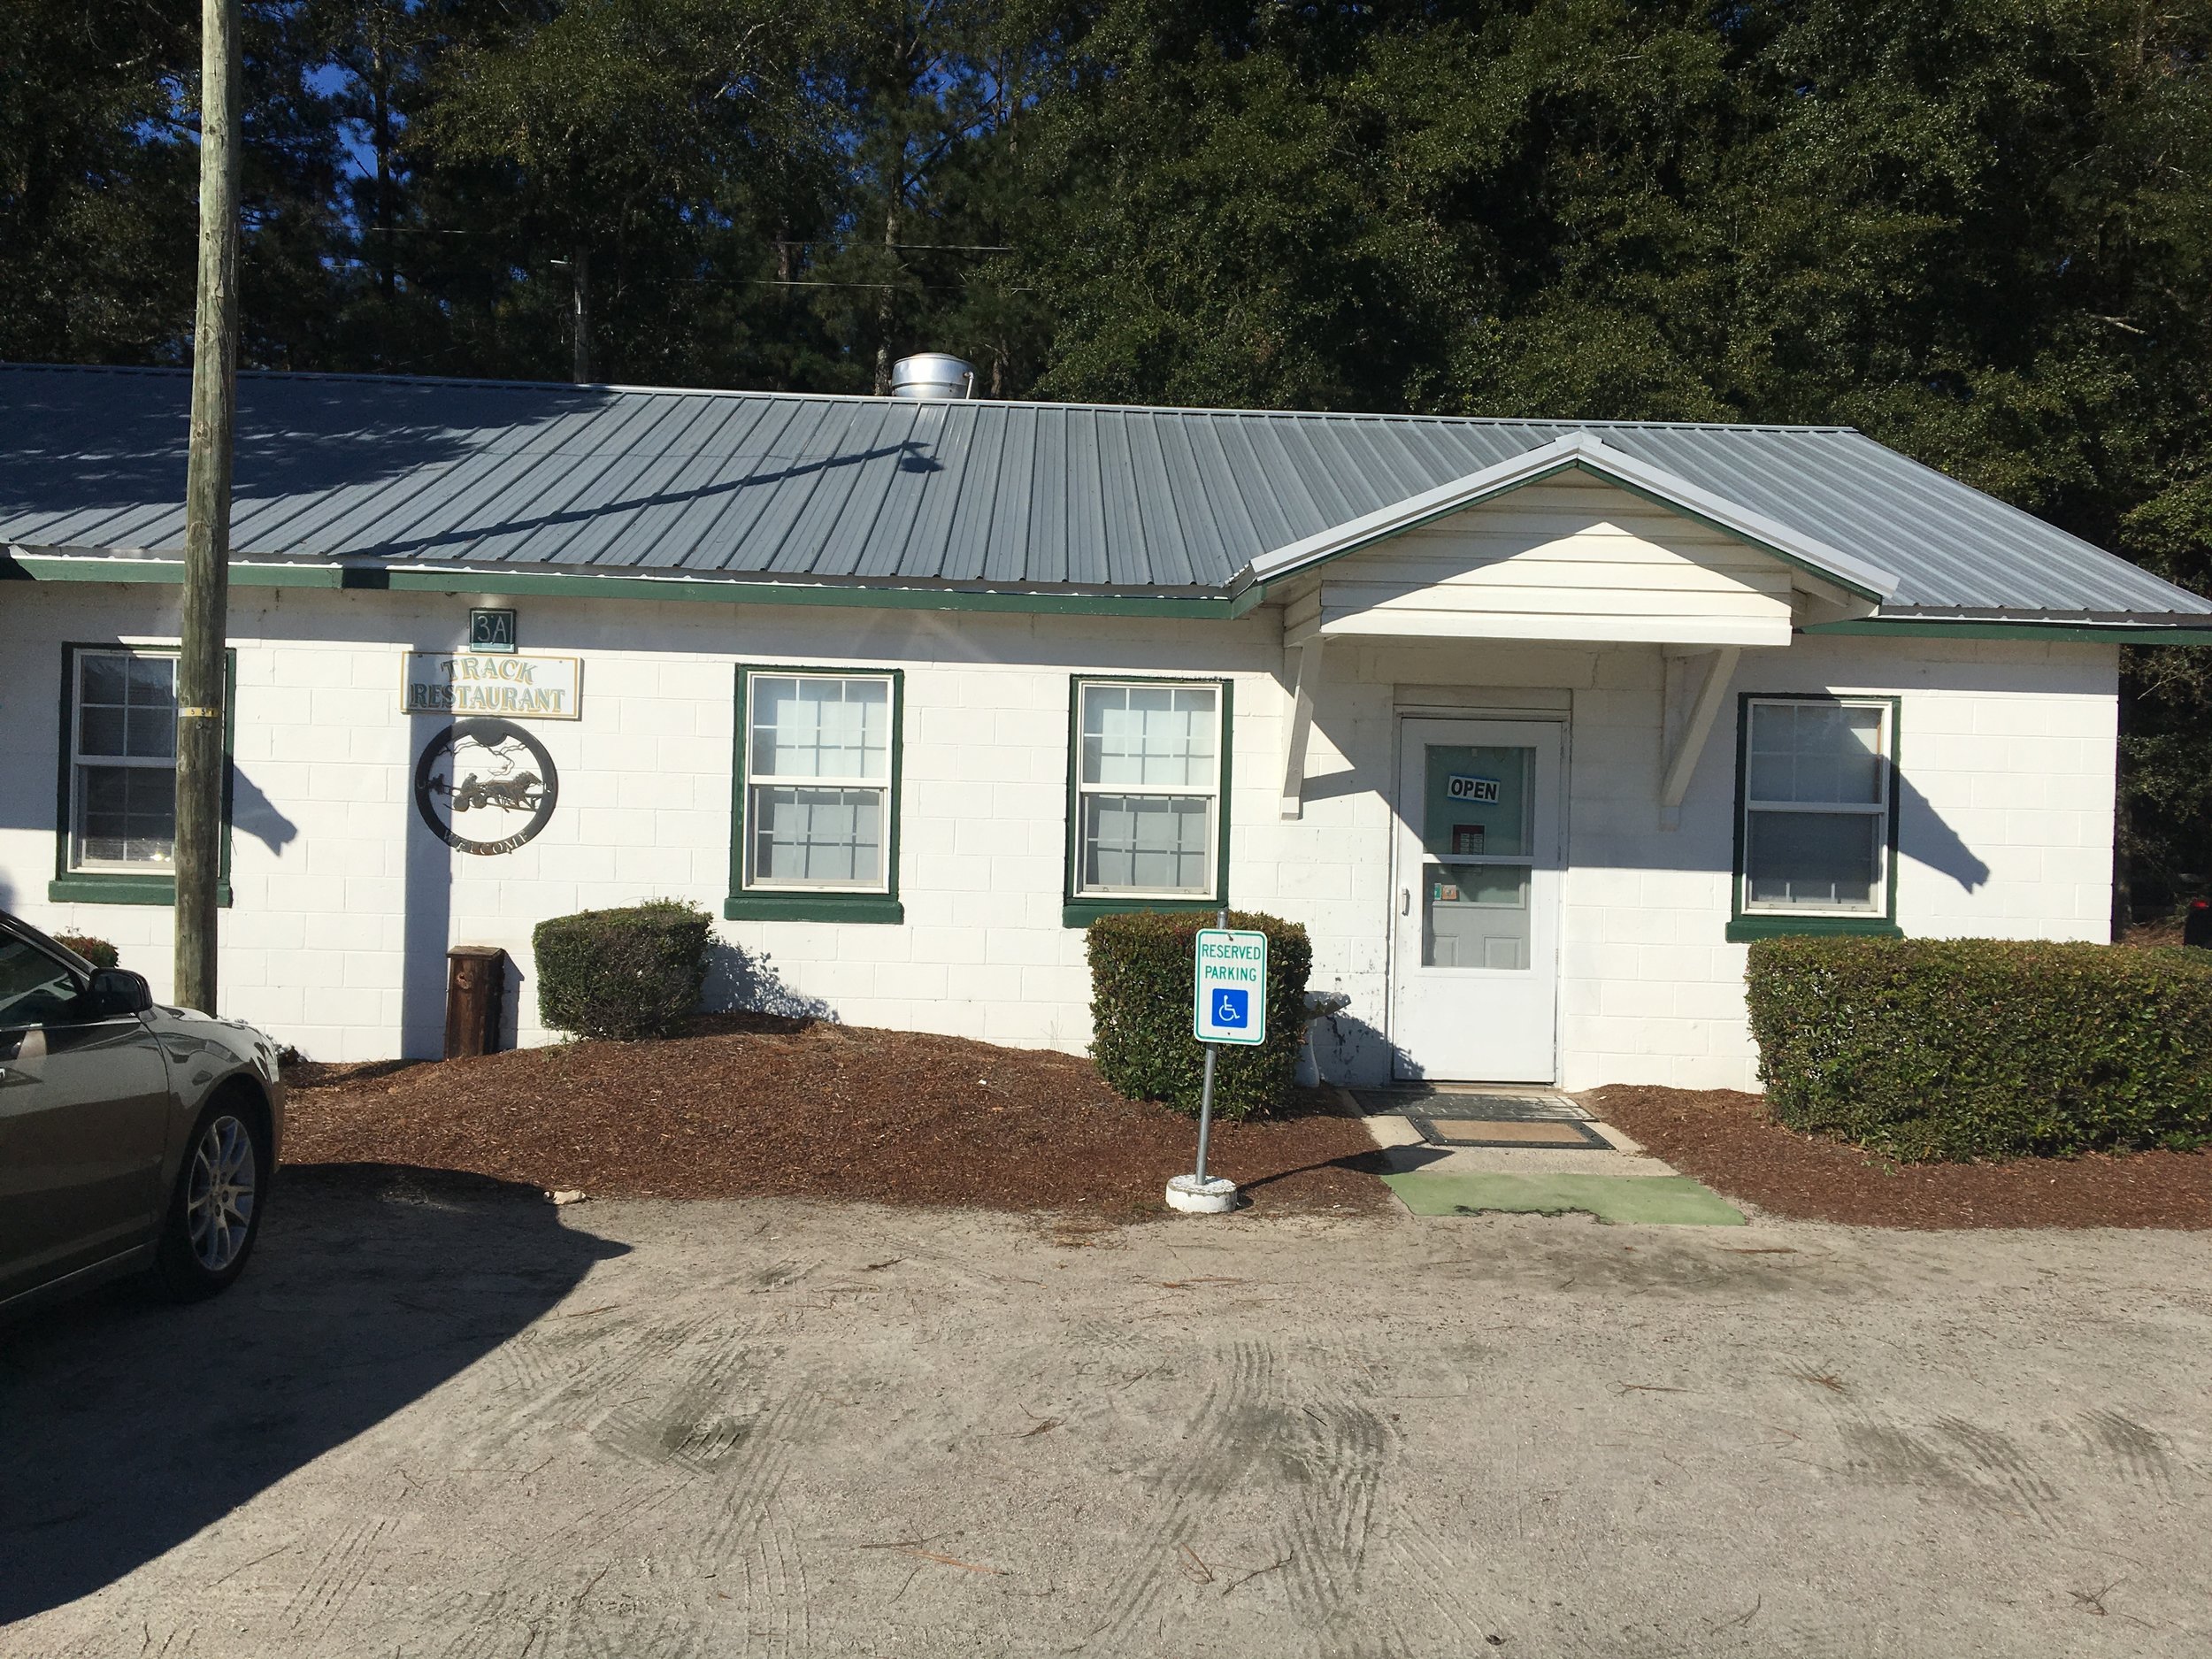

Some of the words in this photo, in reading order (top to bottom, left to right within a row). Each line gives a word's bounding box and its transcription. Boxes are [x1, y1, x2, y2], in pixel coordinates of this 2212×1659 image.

[478, 615, 507, 642] 3A
[441, 657, 537, 685] TRACK
[410, 683, 565, 713] RESTAURANT
[1451, 779, 1497, 801] OPEN
[444, 829, 529, 855] WELCOME
[1202, 944, 1261, 960] RESERVED
[1205, 965, 1256, 982] PARKING
